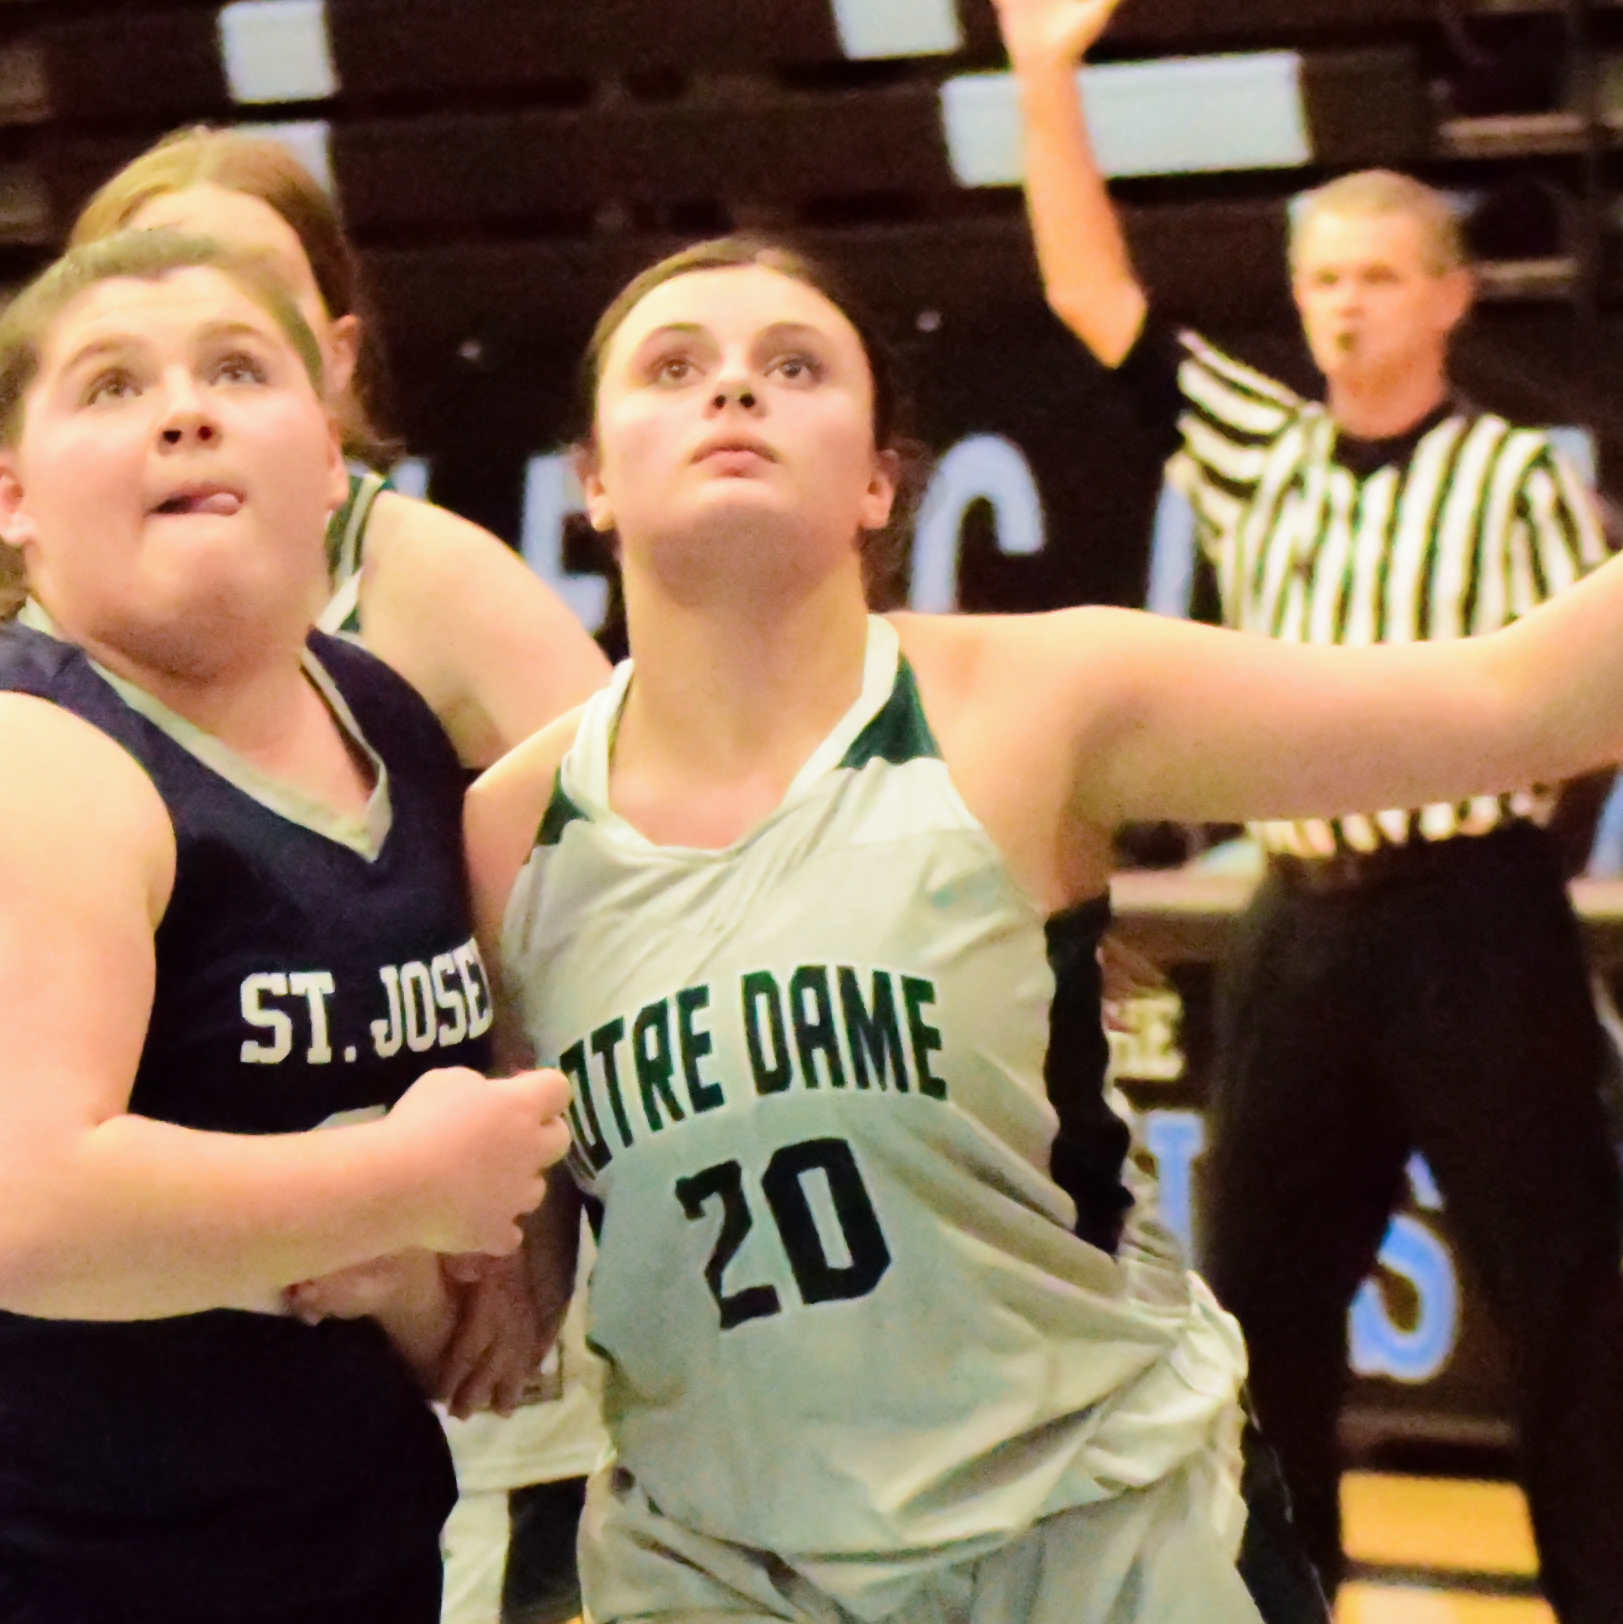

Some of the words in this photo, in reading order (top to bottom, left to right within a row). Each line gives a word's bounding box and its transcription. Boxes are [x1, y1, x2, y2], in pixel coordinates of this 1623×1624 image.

[369, 936, 494, 1059] JOSE
[559, 983, 726, 1180] OTRE
[743, 964, 949, 1102] DAME
[675, 1136, 892, 1331] 20
